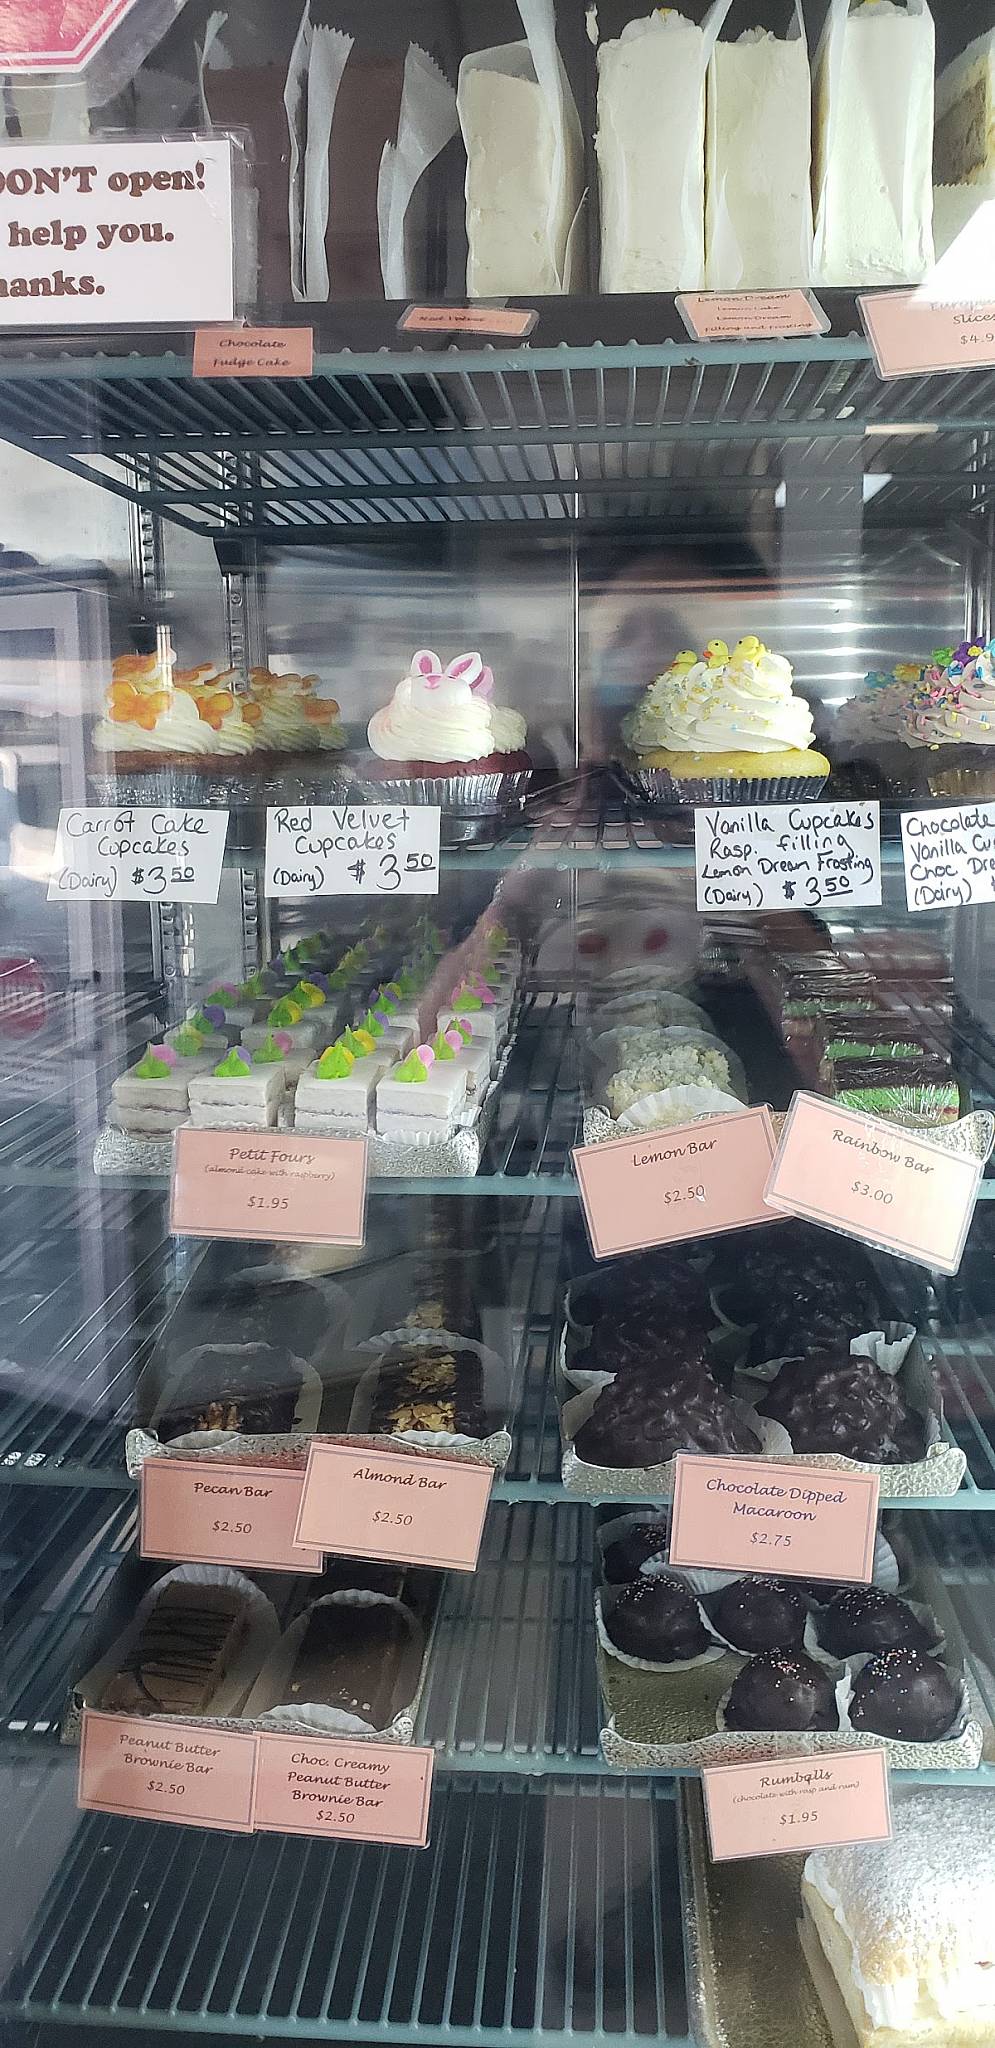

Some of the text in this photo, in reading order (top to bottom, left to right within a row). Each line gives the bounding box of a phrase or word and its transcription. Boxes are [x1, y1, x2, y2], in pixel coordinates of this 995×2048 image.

[0, 160, 205, 197] ON'T open!
[8, 220, 174, 250] help you.
[219, 339, 286, 348] Chocolate
[257, 358, 290, 367] Cake
[66, 810, 209, 837] Carrot Cake
[274, 806, 410, 833] Red Velvet
[705, 808, 874, 837] Vanilla Cupcakes
[906, 808, 995, 837] Chocolate
[97, 836, 190, 858] Cupcakes
[295, 831, 397, 859] Cupcakes
[710, 834, 854, 861] Rasp. filling
[911, 834, 995, 863] Vanilla Cu
[272, 865, 325, 892] (Dairy)
[701, 850, 874, 885] Lemon Dream Frosting
[58, 866, 118, 898] (Dairy)
[914, 878, 972, 906] (Dairy)
[704, 882, 764, 908] (Dairy)
[228, 1148, 316, 1164] Petit Fours
[633, 1138, 718, 1167] Lemon Bar
[832, 1129, 935, 1175] Rainbow Bar
[204, 1164, 245, 1174] (almond
[246, 1168, 267, 1176] cake
[269, 1168, 288, 1177] with
[247, 1196, 290, 1210] $1.95
[664, 1184, 705, 1204] $2.50
[851, 1180, 894, 1205] $3.00
[193, 1482, 273, 1498] Pecan Bar
[353, 1468, 448, 1491] Almond Bar
[706, 1478, 848, 1505] Chocolate Dipped
[372, 1510, 413, 1527] $2.50
[732, 1502, 817, 1521] Macaroon
[212, 1520, 253, 1535] $2.50
[750, 1532, 792, 1547] $2.75
[119, 1734, 222, 1758] Peanut Butter
[124, 1753, 214, 1775] Brownie Bar
[291, 1753, 391, 1775] Choc. Creamy
[147, 1780, 186, 1796] $2.50
[287, 1771, 391, 1791] Peanut Butter
[759, 1768, 833, 1788] Rumballs
[291, 1790, 384, 1808] Brownie Bar
[732, 1792, 777, 1804] (chocolate
[779, 1788, 798, 1797] with
[818, 1783, 837, 1791] and
[838, 1780, 860, 1789] rum)
[316, 1810, 356, 1824] $2.50
[779, 1810, 819, 1826] $1.95
